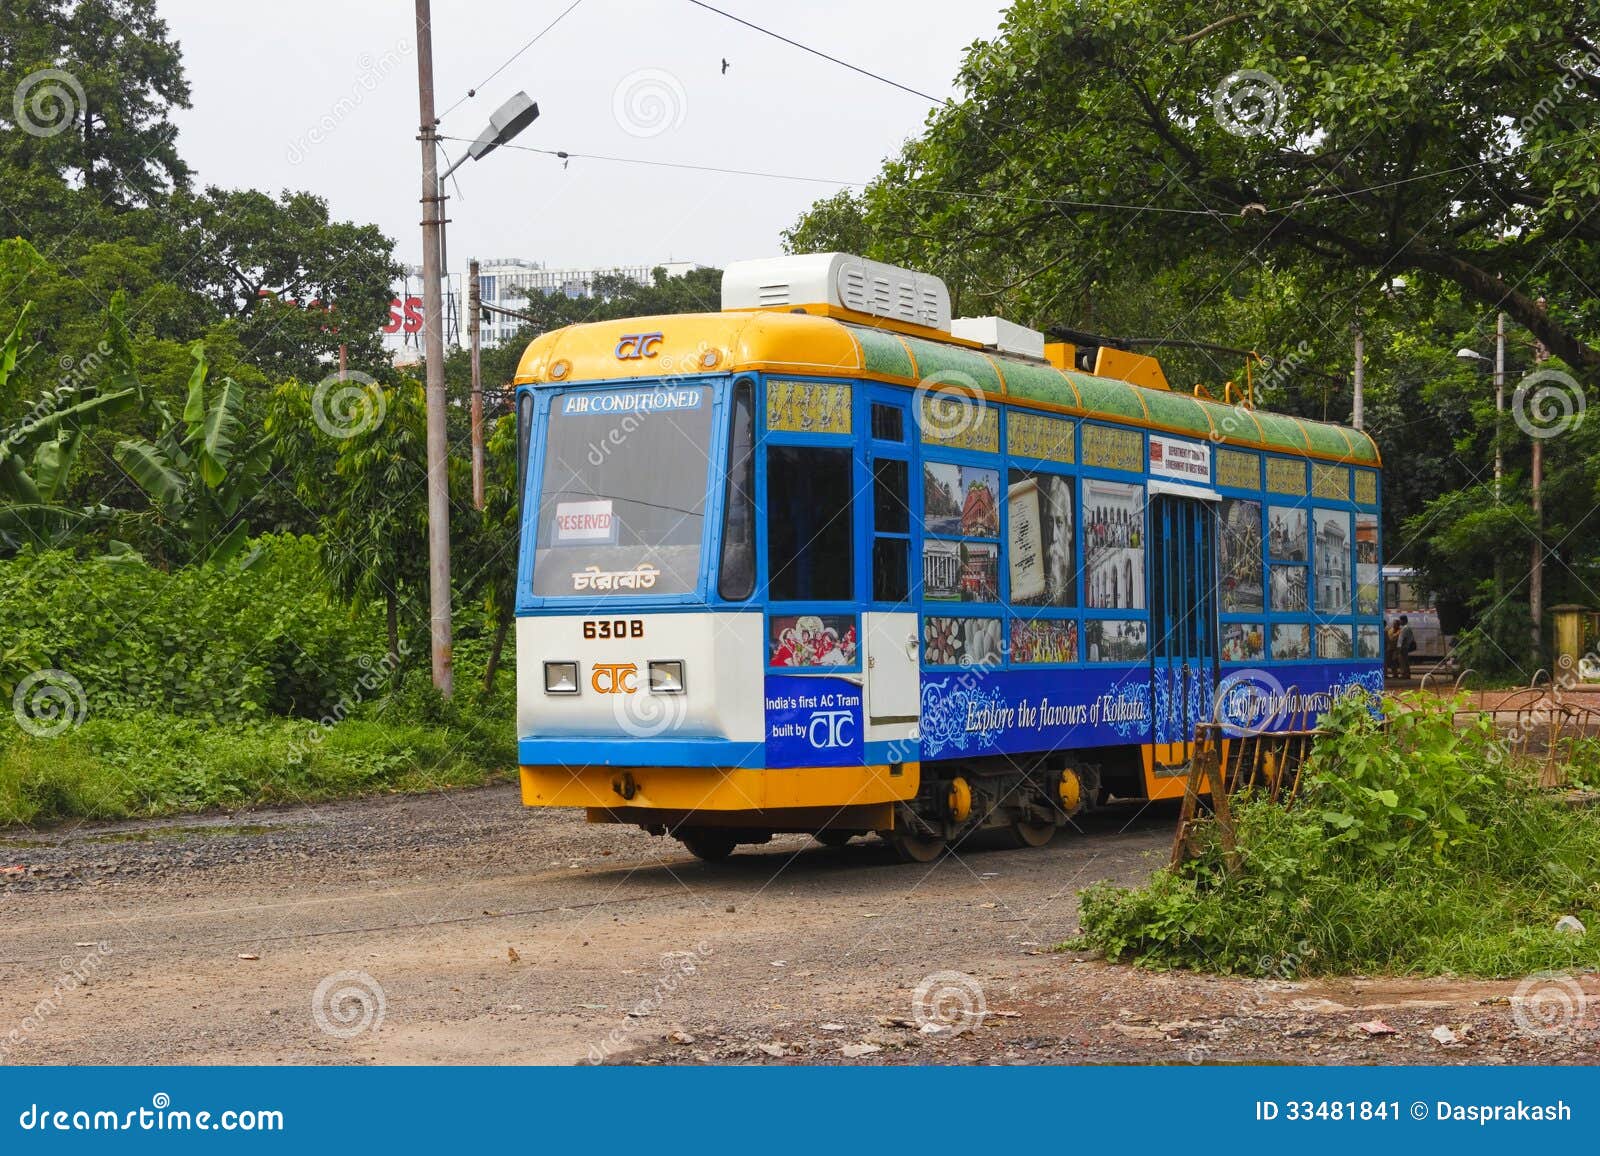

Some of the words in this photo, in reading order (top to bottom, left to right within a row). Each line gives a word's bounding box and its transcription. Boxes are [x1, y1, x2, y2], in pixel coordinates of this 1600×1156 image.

[614, 331, 664, 361] CTC
[565, 396, 589, 413] AIR
[590, 391, 700, 412] CONDITIONED
[557, 514, 611, 530] RESERVED
[583, 619, 644, 639] 630B
[591, 662, 639, 694] CTC
[766, 697, 797, 710] India's
[799, 696, 817, 708] first
[820, 694, 834, 707] AC
[836, 693, 859, 706] Tram
[772, 724, 794, 737] built
[796, 723, 807, 739] by
[809, 710, 855, 748] CTC
[966, 700, 1014, 737] Explore
[1018, 699, 1036, 729] the
[1038, 697, 1087, 731] flavours
[1090, 695, 1101, 728] of
